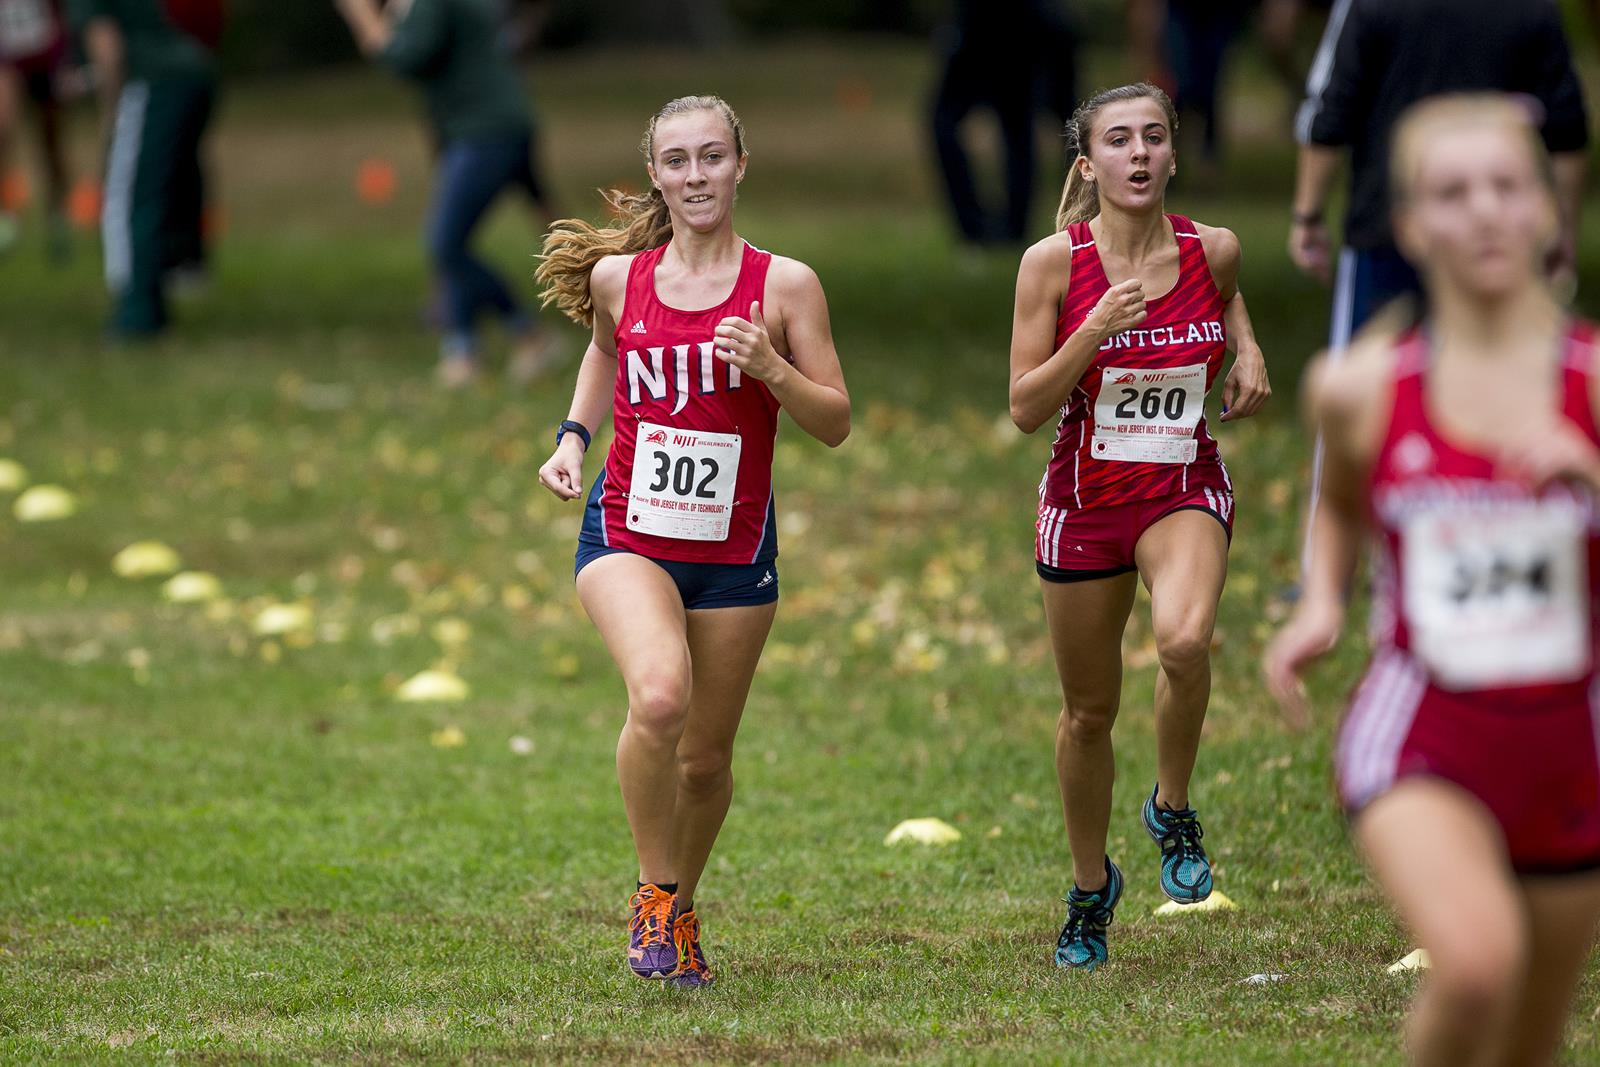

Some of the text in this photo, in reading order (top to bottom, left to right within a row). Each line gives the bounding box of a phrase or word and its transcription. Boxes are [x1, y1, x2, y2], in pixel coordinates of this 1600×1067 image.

[1099, 321, 1224, 351] NTCLAIR
[1142, 373, 1167, 383] NJIT
[1115, 387, 1187, 420] 260
[1117, 424, 1127, 433] NEW
[1128, 425, 1145, 434] JERSEY
[1146, 425, 1157, 434] INST.
[1158, 426, 1164, 435] OF
[1165, 426, 1193, 436] TECHNOLOGY
[673, 434, 697, 448] NJIT
[649, 450, 719, 499] 302
[650, 497, 660, 507] NEW
[660, 499, 678, 510] JERSEY
[678, 502, 690, 511] INST.
[690, 503, 697, 512] OF
[697, 504, 725, 513] TECHNOLOGY
